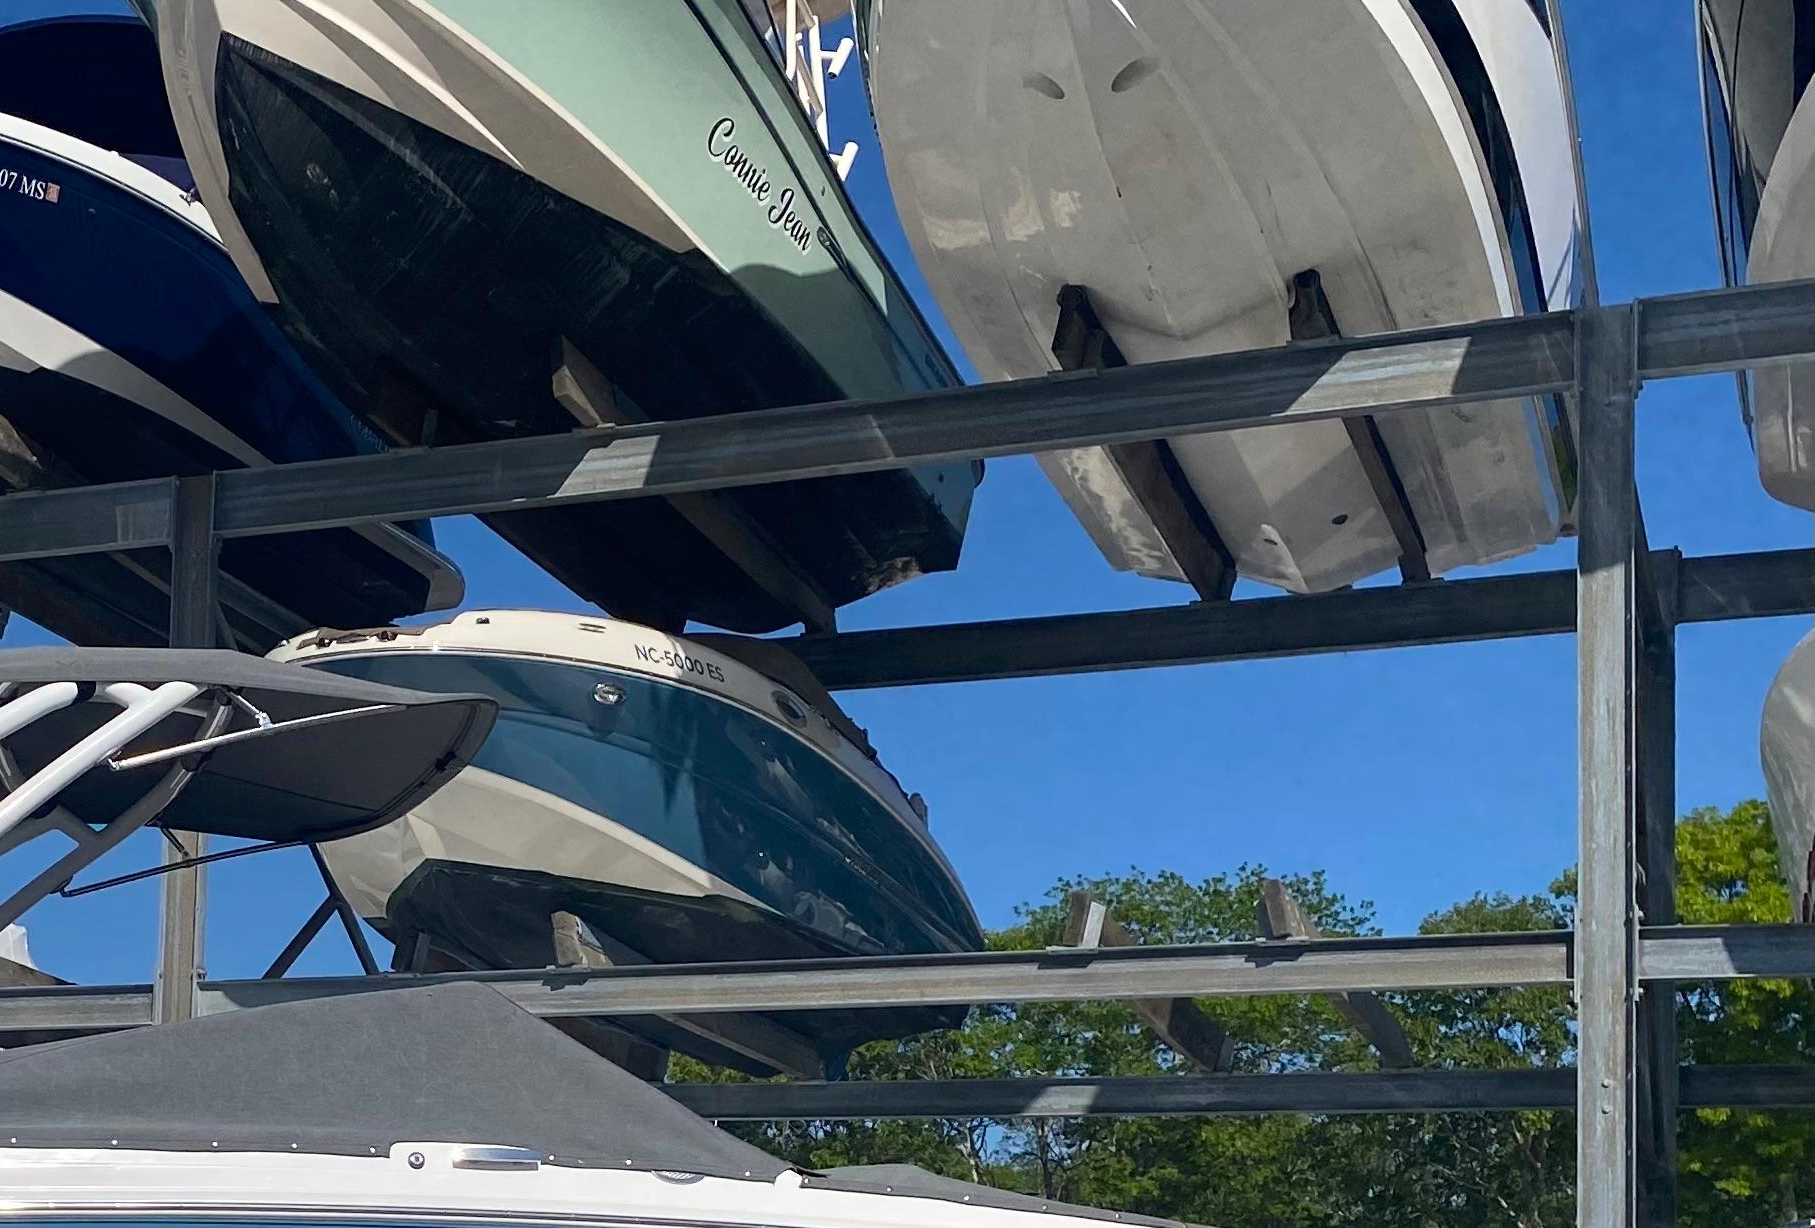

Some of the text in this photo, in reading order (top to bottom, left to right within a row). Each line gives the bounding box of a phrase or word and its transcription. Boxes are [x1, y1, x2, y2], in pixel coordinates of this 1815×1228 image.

[18, 174, 46, 200] MS
[707, 117, 811, 252] Connie Jean
[705, 662, 725, 683] ES
